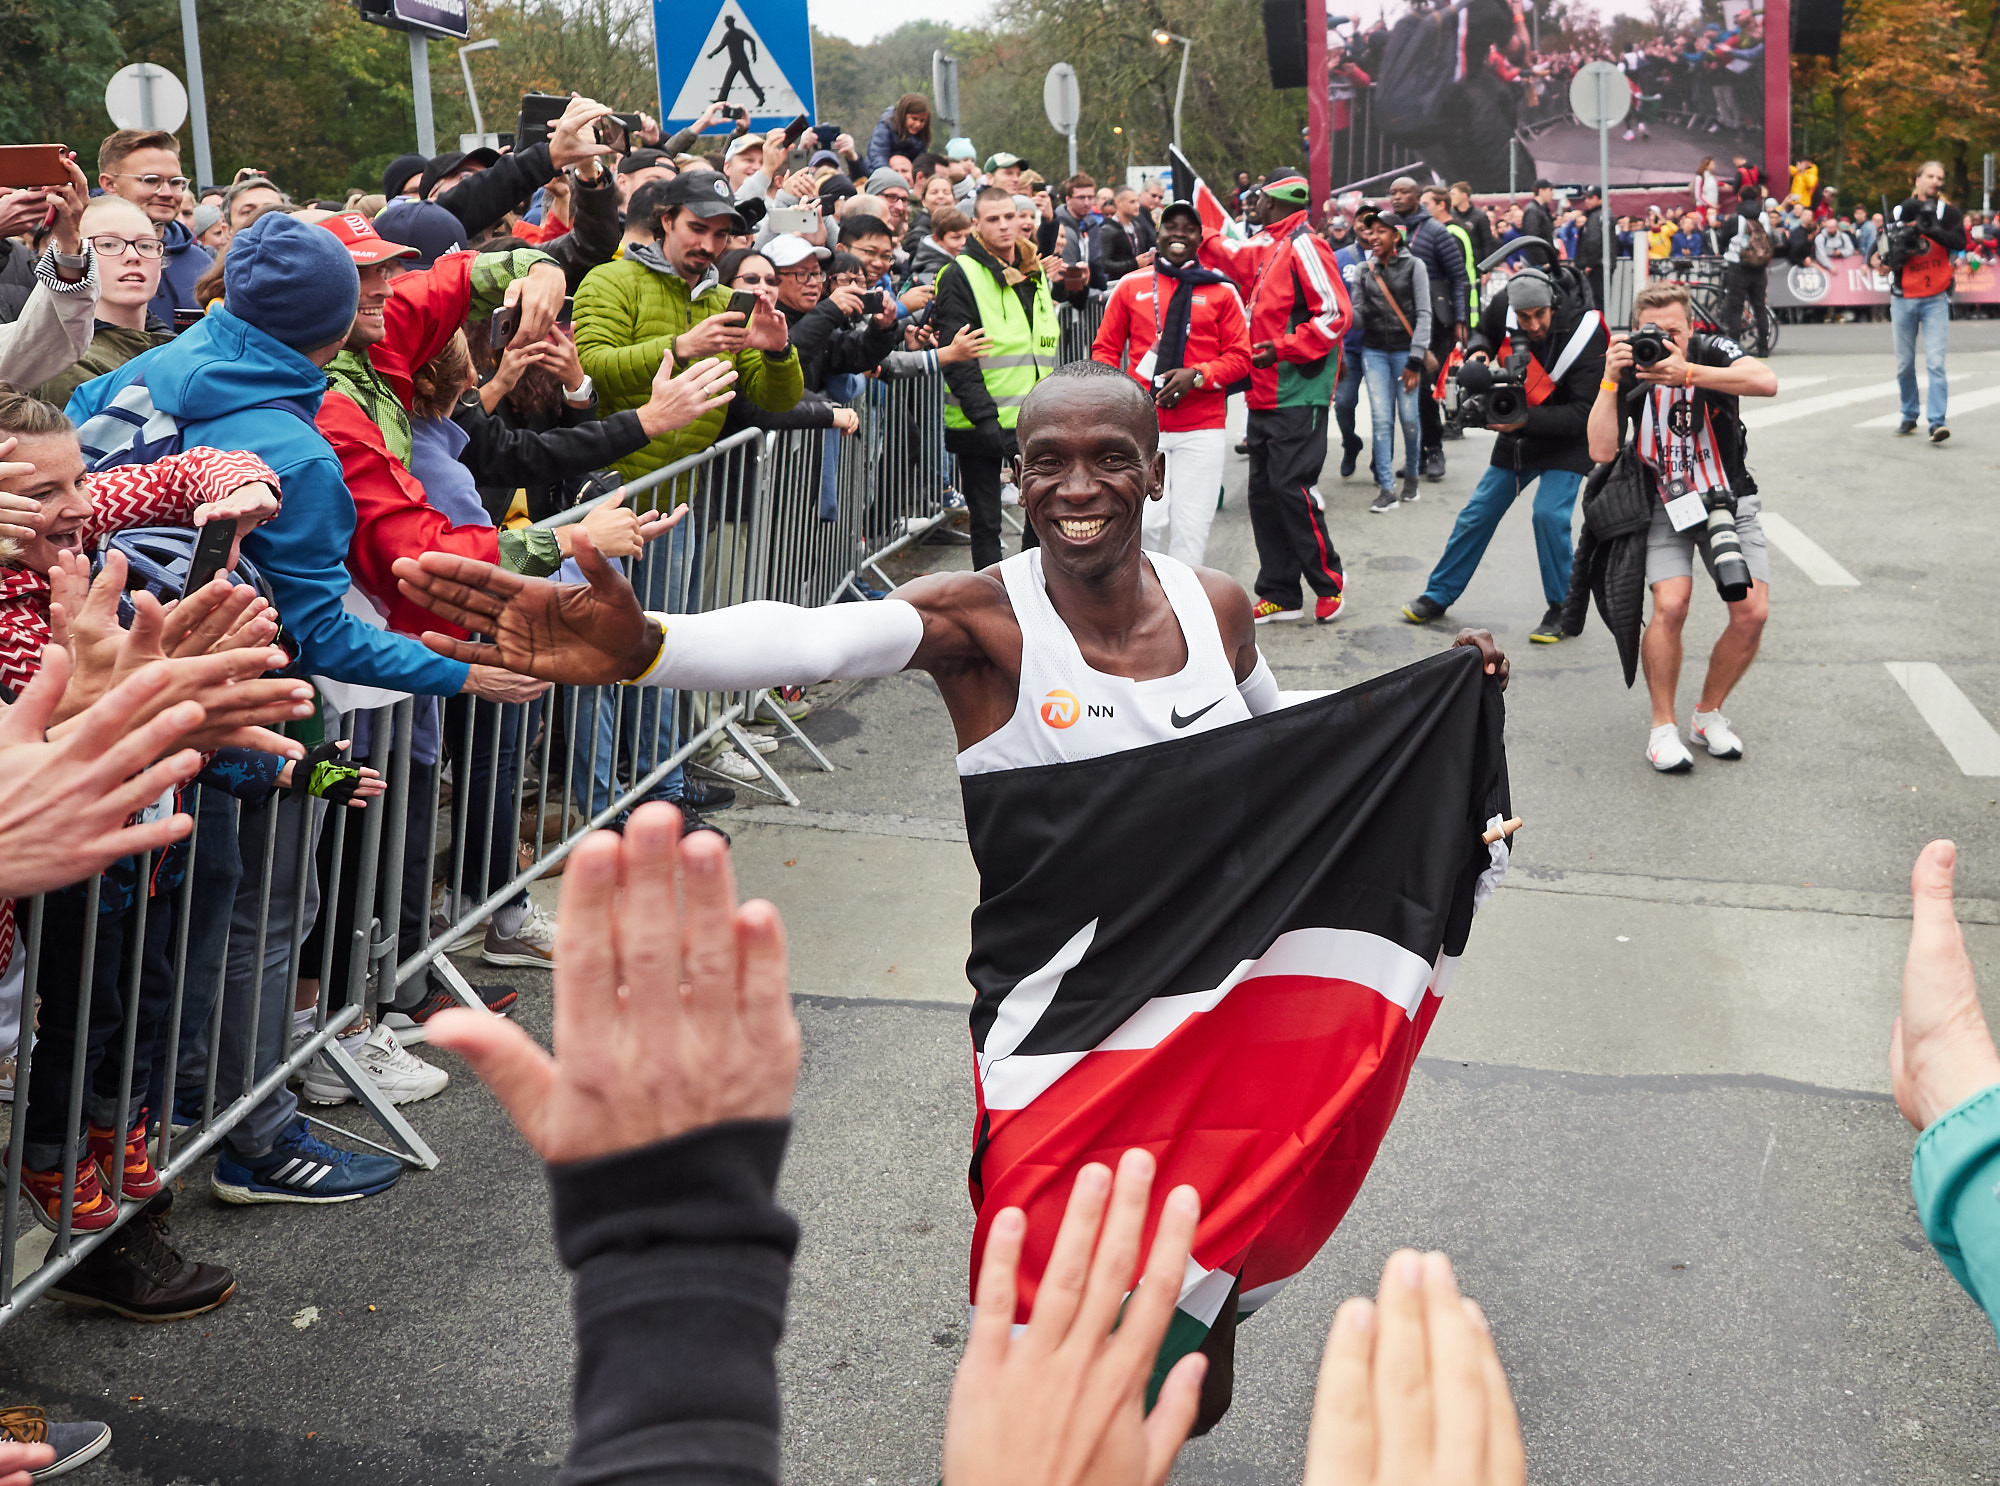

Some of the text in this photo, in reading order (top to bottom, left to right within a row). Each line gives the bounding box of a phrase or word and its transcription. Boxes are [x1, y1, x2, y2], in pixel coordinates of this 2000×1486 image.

[349, 249, 378, 258] NGARY
[1924, 276, 1931, 288] 2
[1087, 705, 1114, 718] NN
